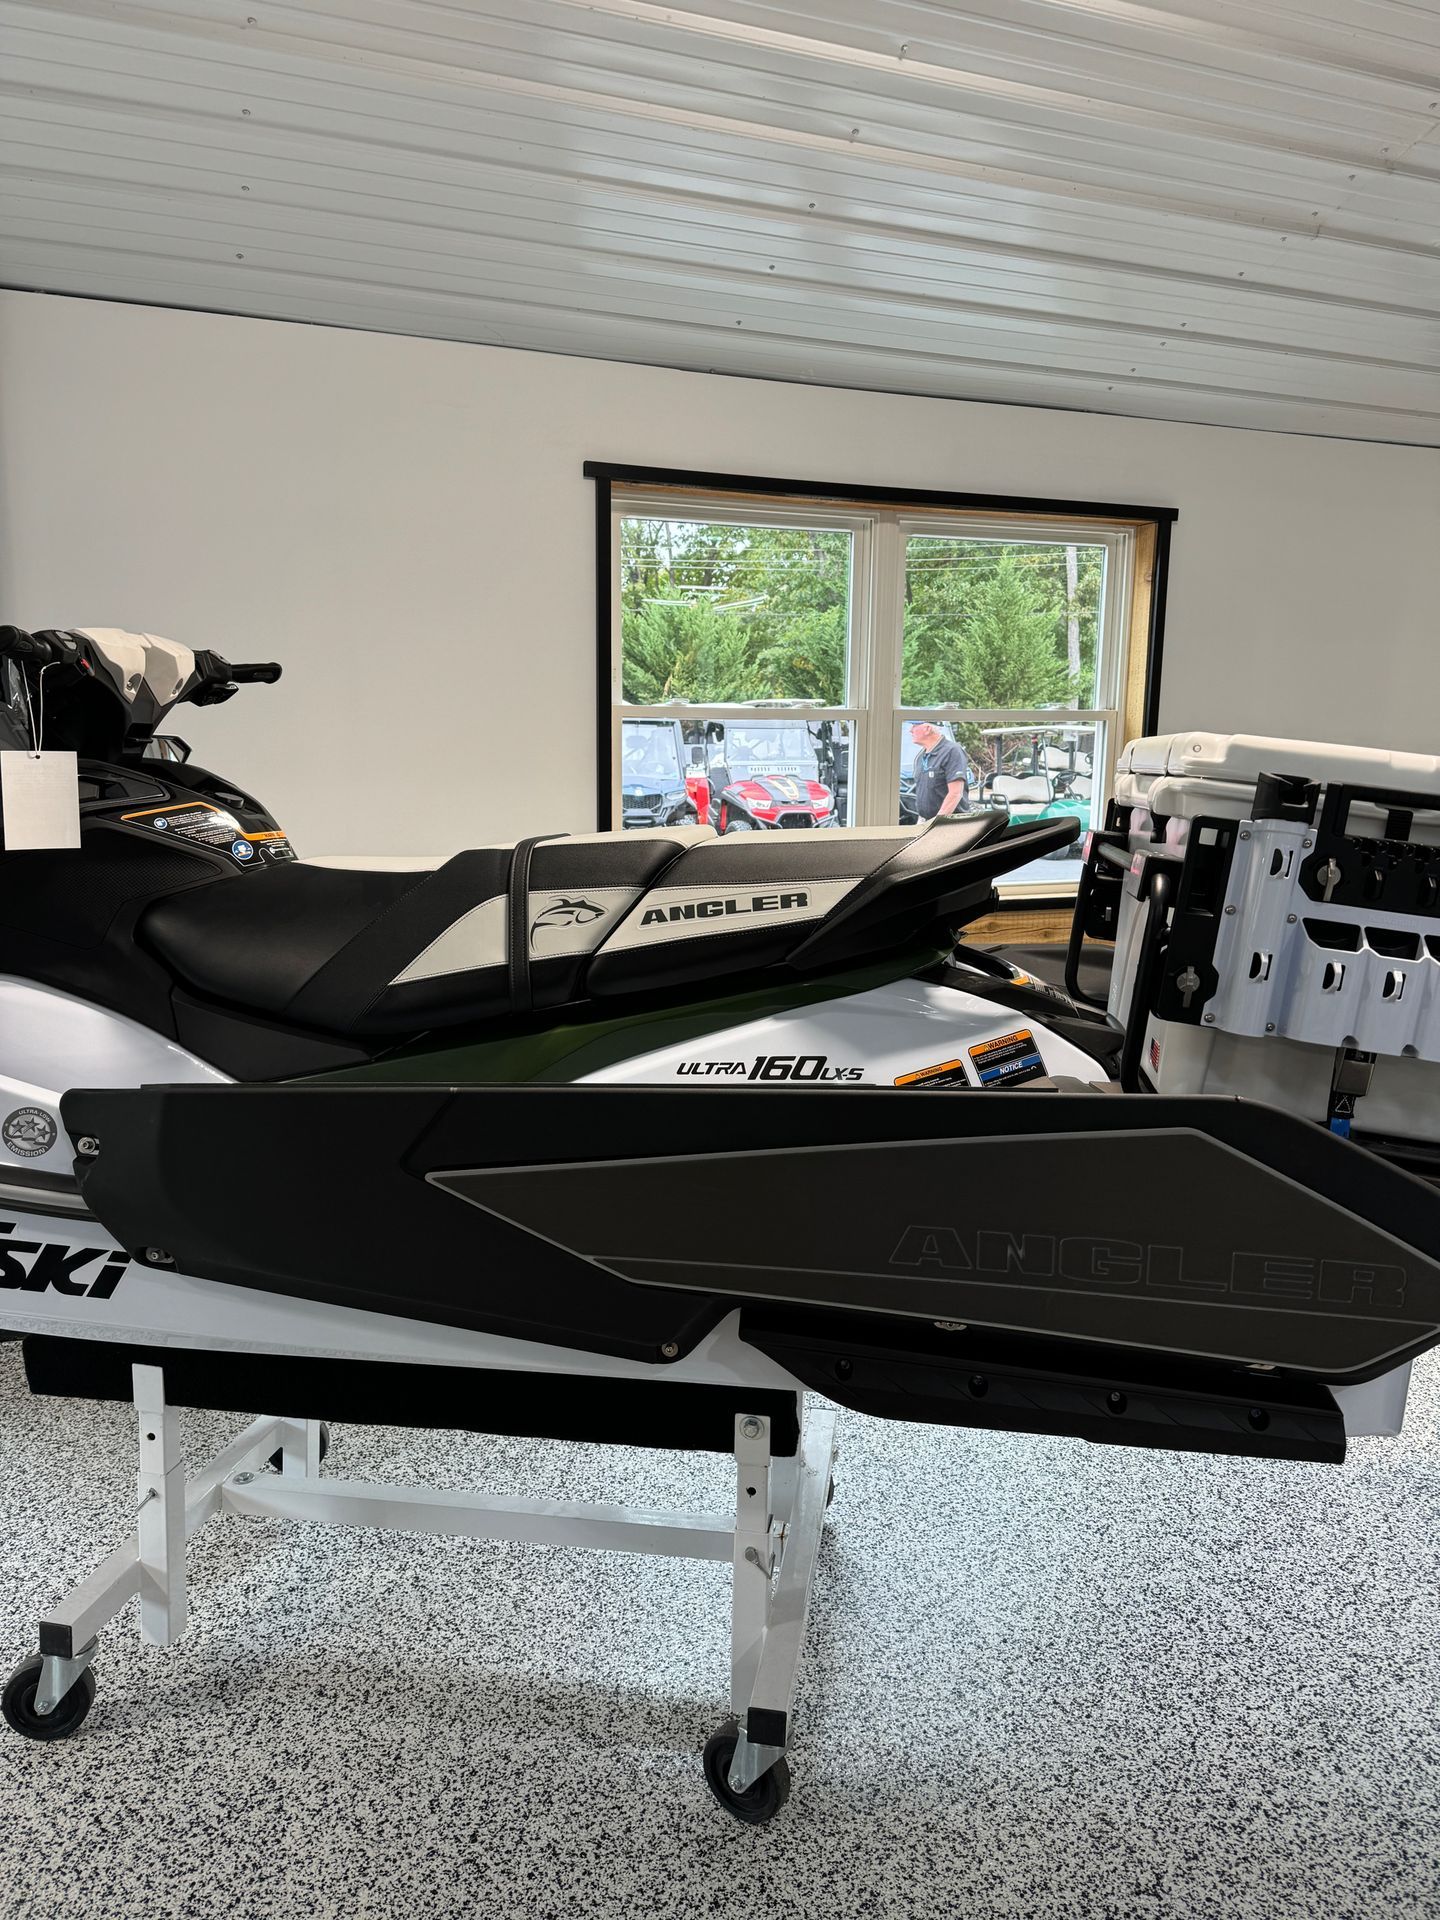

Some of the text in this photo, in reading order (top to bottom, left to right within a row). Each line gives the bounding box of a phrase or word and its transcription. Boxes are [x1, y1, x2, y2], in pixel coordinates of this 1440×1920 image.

[640, 892, 809, 926] ANGLER
[987, 1034, 1019, 1050] WARNING
[676, 1062, 747, 1075] ULTRA
[747, 1056, 828, 1081] 160
[1000, 1061, 1023, 1075] NOTICE
[7, 1141, 46, 1157] EMISSION
[888, 1225, 1408, 1308] ANGLER
